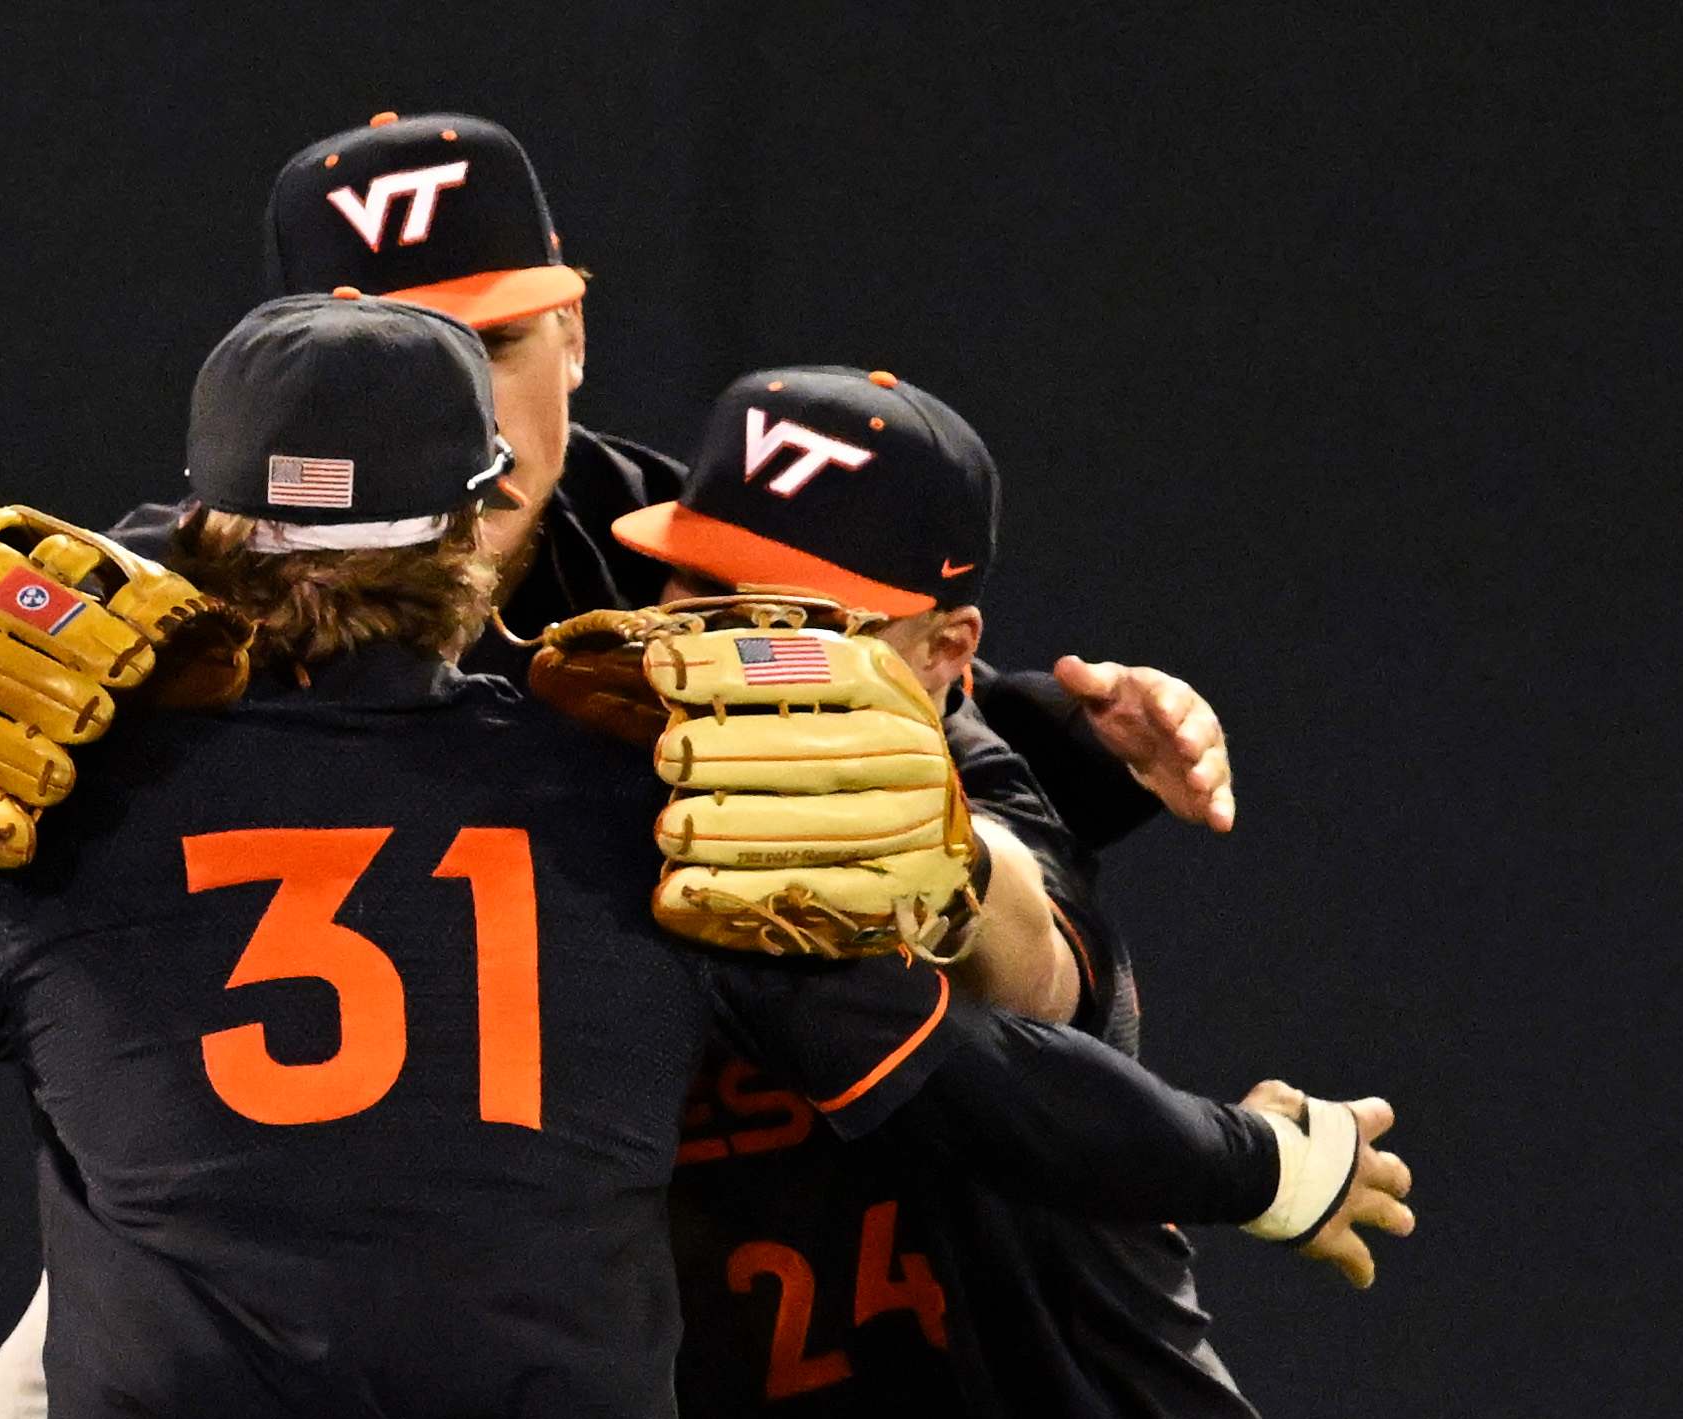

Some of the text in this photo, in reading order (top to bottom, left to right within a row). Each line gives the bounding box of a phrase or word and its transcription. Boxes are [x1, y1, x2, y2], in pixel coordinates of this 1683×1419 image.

[327, 160, 469, 252] VT
[744, 406, 874, 499] VT
[181, 826, 542, 1130] 31
[726, 1200, 950, 1400] 24
